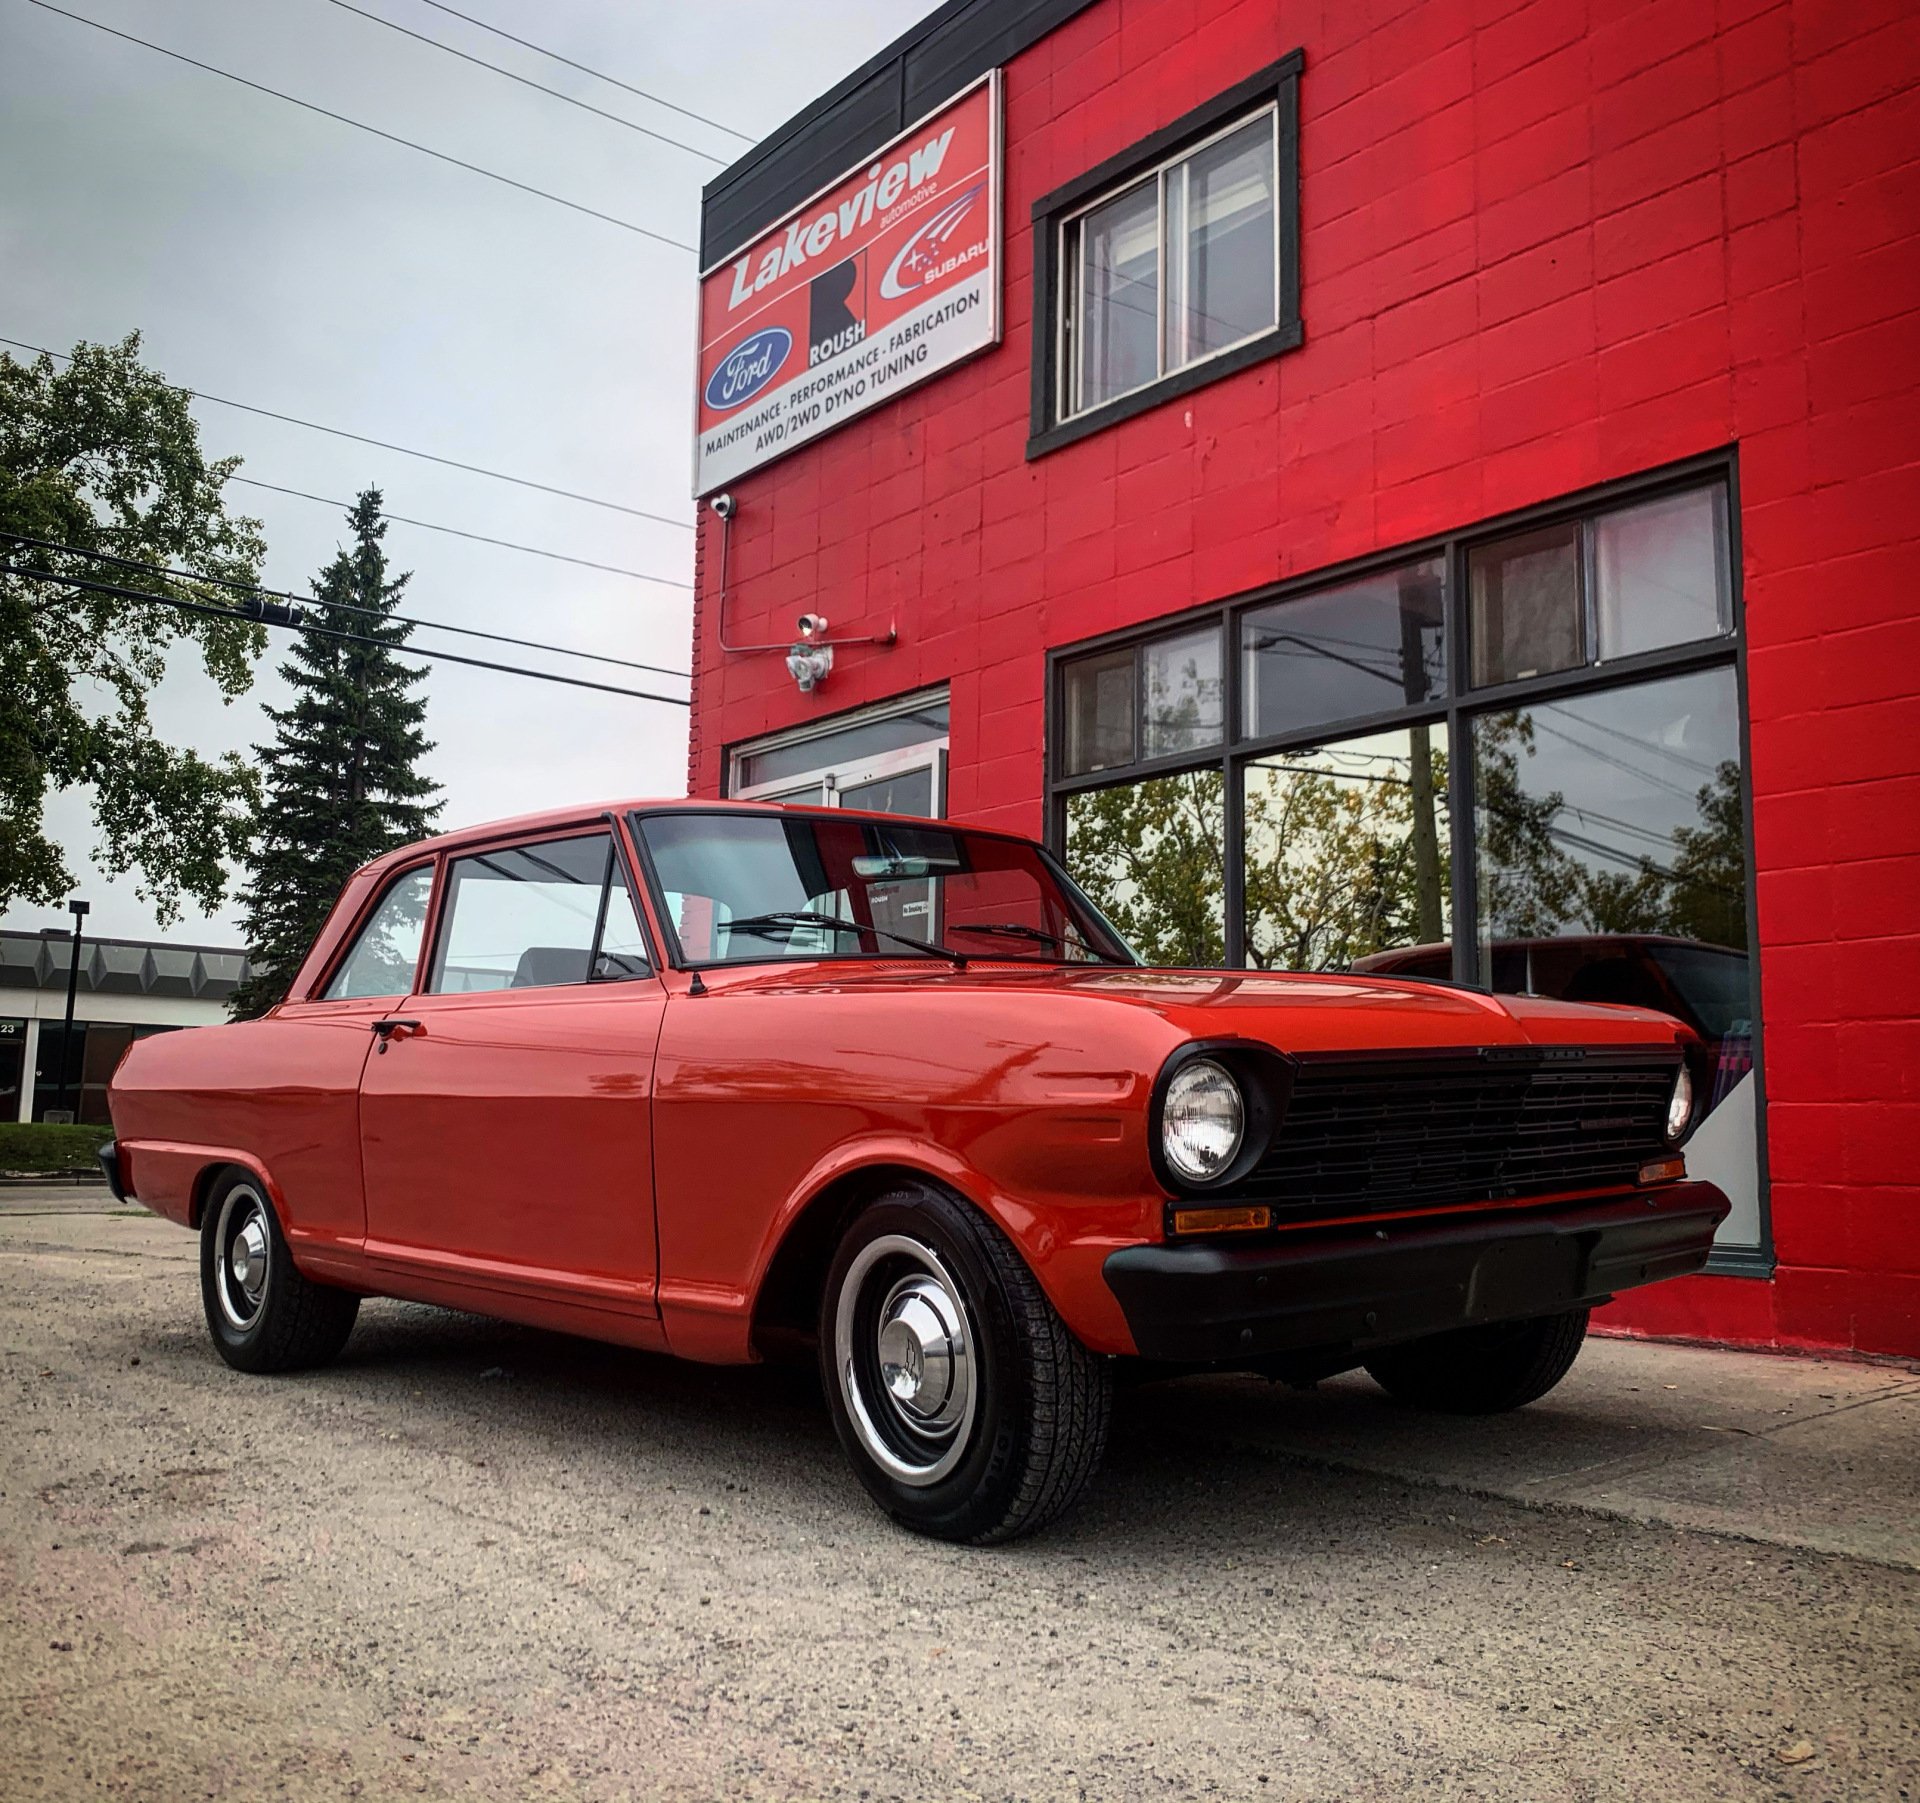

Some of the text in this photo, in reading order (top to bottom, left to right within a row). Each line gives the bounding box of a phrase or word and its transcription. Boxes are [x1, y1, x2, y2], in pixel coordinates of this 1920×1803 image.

[728, 127, 955, 311] Lakeview
[880, 182, 938, 229] automotive
[924, 238, 990, 285] SUBARU
[810, 319, 866, 367] ROUSH
[705, 402, 781, 457] MAINTENANCE
[790, 347, 879, 411] PERFORMANCE
[889, 289, 980, 348] FABRICATION
[722, 342, 773, 400] Ford
[755, 343, 928, 453] AWD/2WD DYNO TUNING
[0, 1024, 15, 1033] 23
